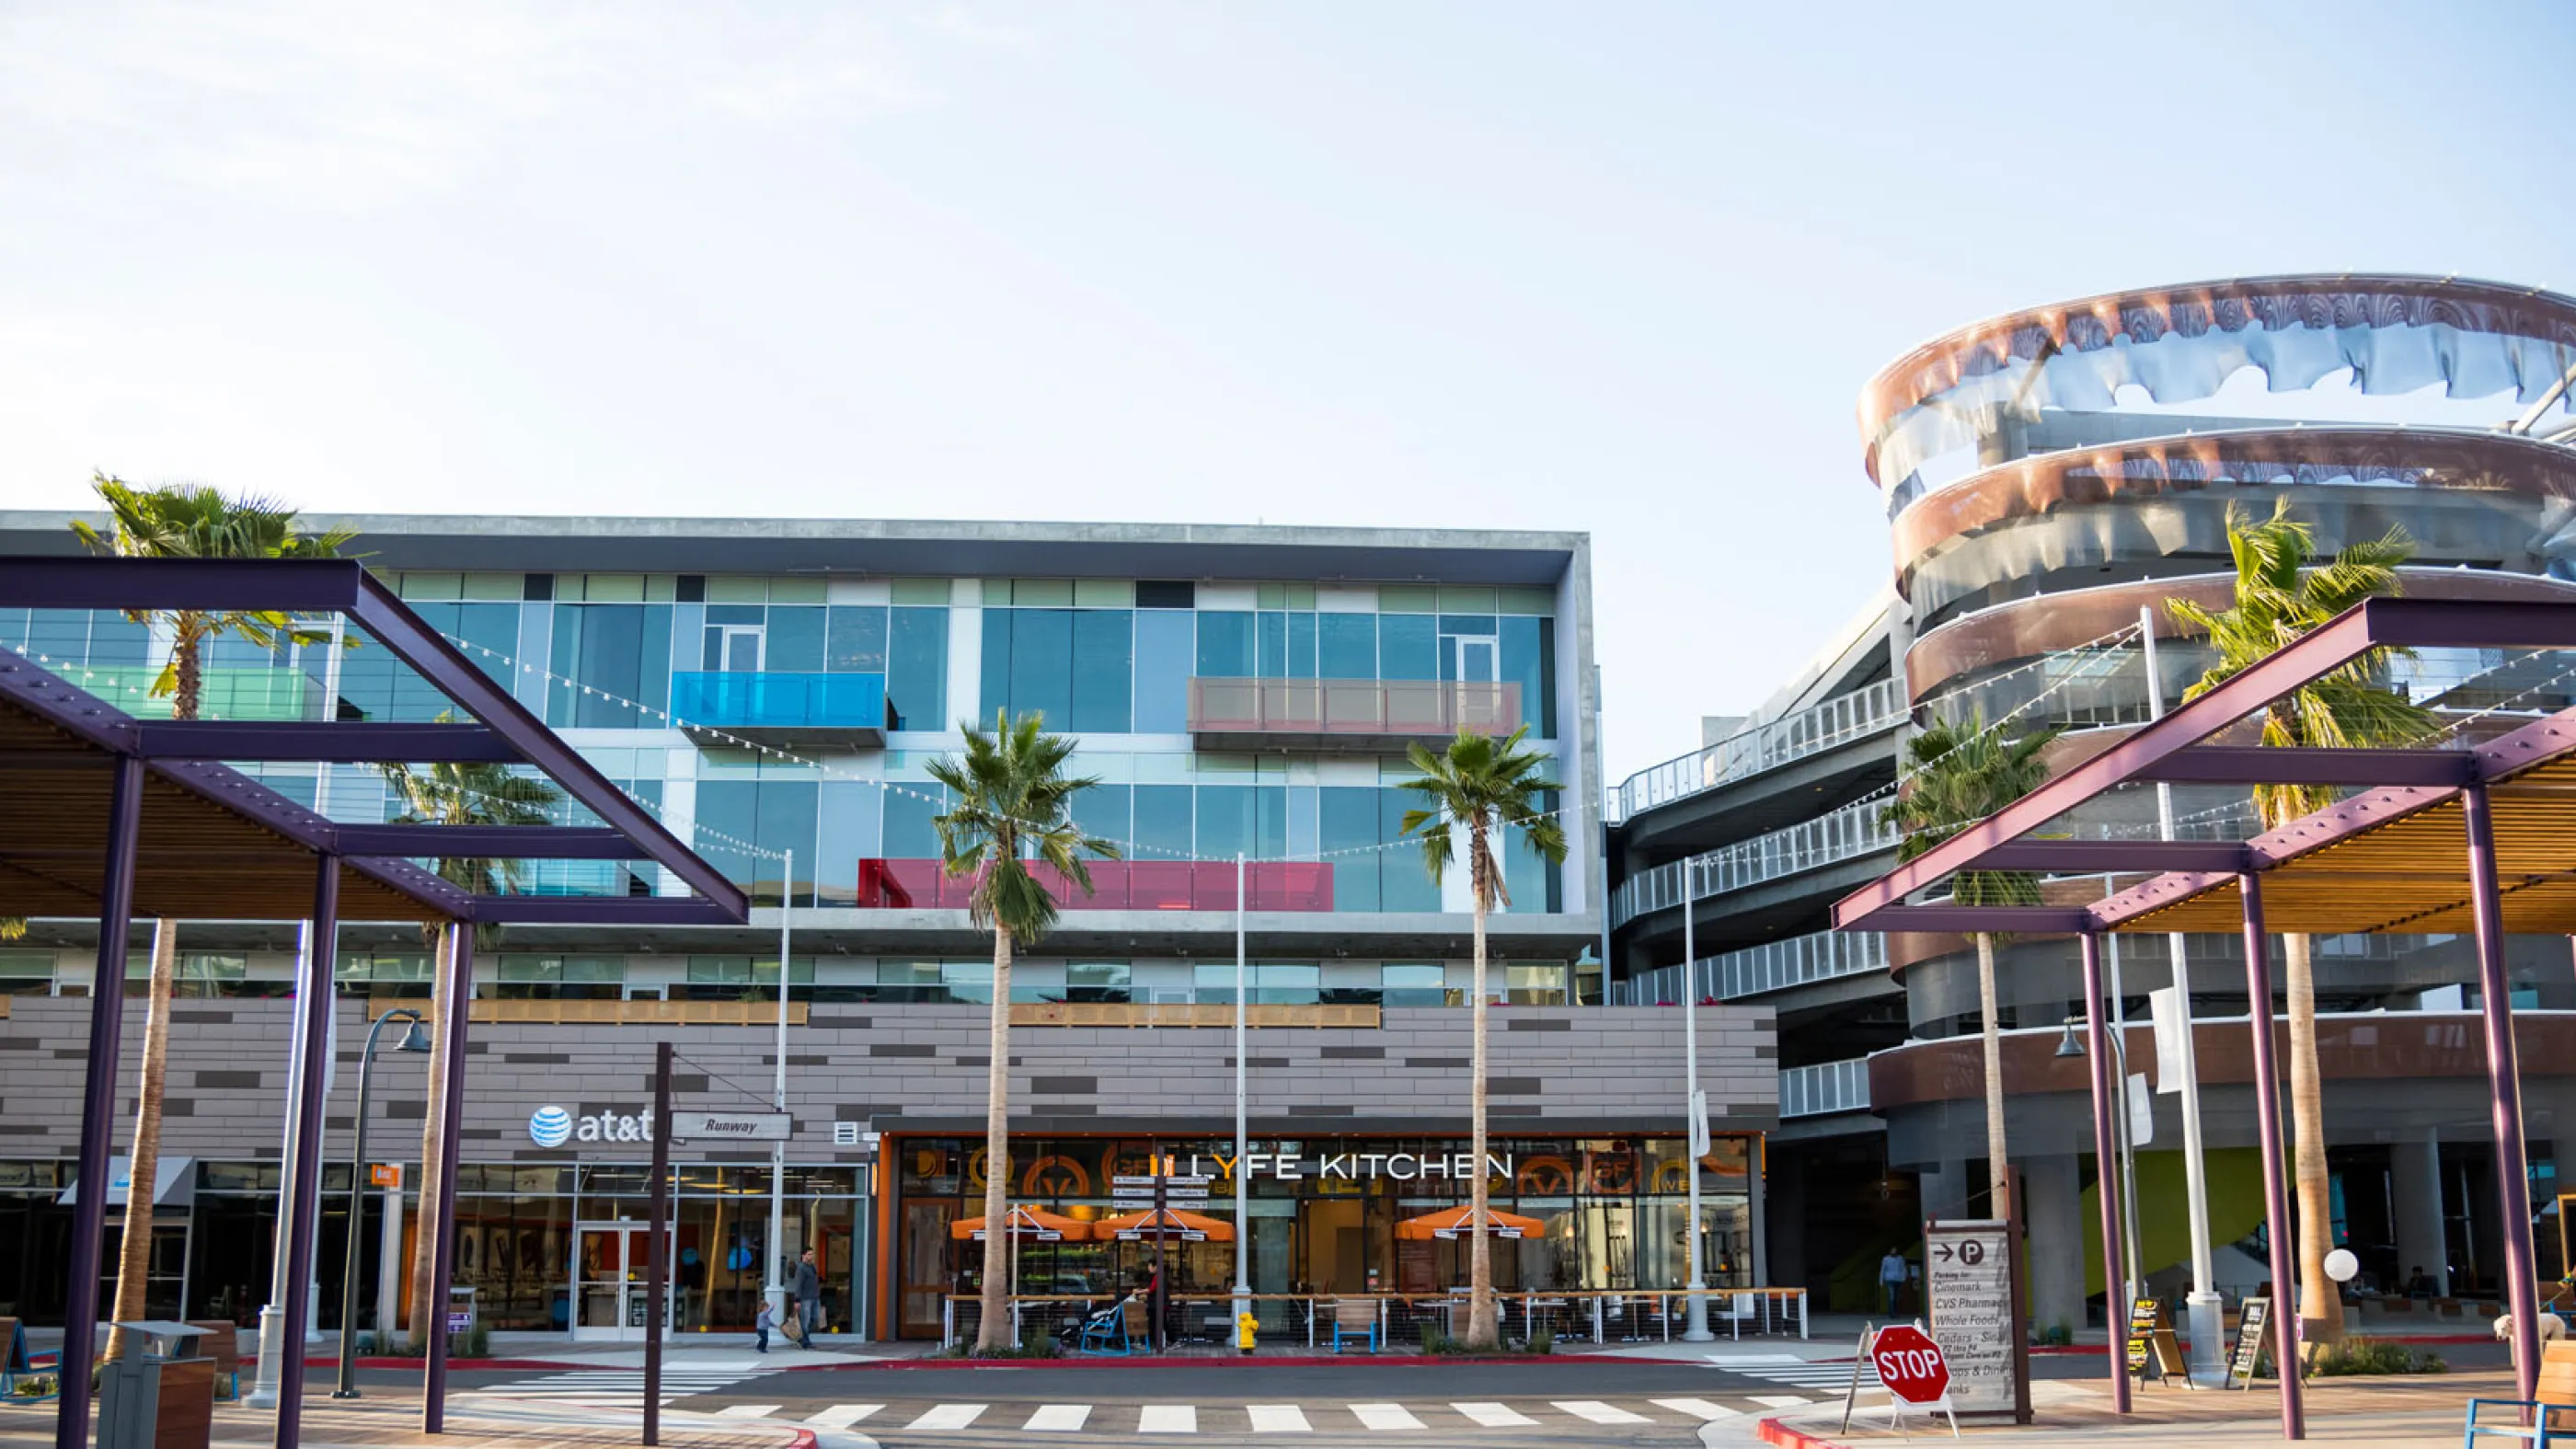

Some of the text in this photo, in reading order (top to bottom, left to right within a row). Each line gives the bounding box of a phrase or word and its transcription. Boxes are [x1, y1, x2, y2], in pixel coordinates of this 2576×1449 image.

[577, 1109, 655, 1142] at&t
[705, 1118, 758, 1133] Runway
[1190, 1153, 1512, 1179] LYFE KITCHEN
[1934, 1282, 1982, 1293] Cinemark
[1935, 1298, 1957, 1309] CVS
[1935, 1314, 2000, 1326] Whole Foods
[1937, 1332, 1972, 1343] Cedars
[1880, 1350, 1939, 1380] STOP
[1972, 1365, 1980, 1377] &
[1947, 1383, 1971, 1394] anks
